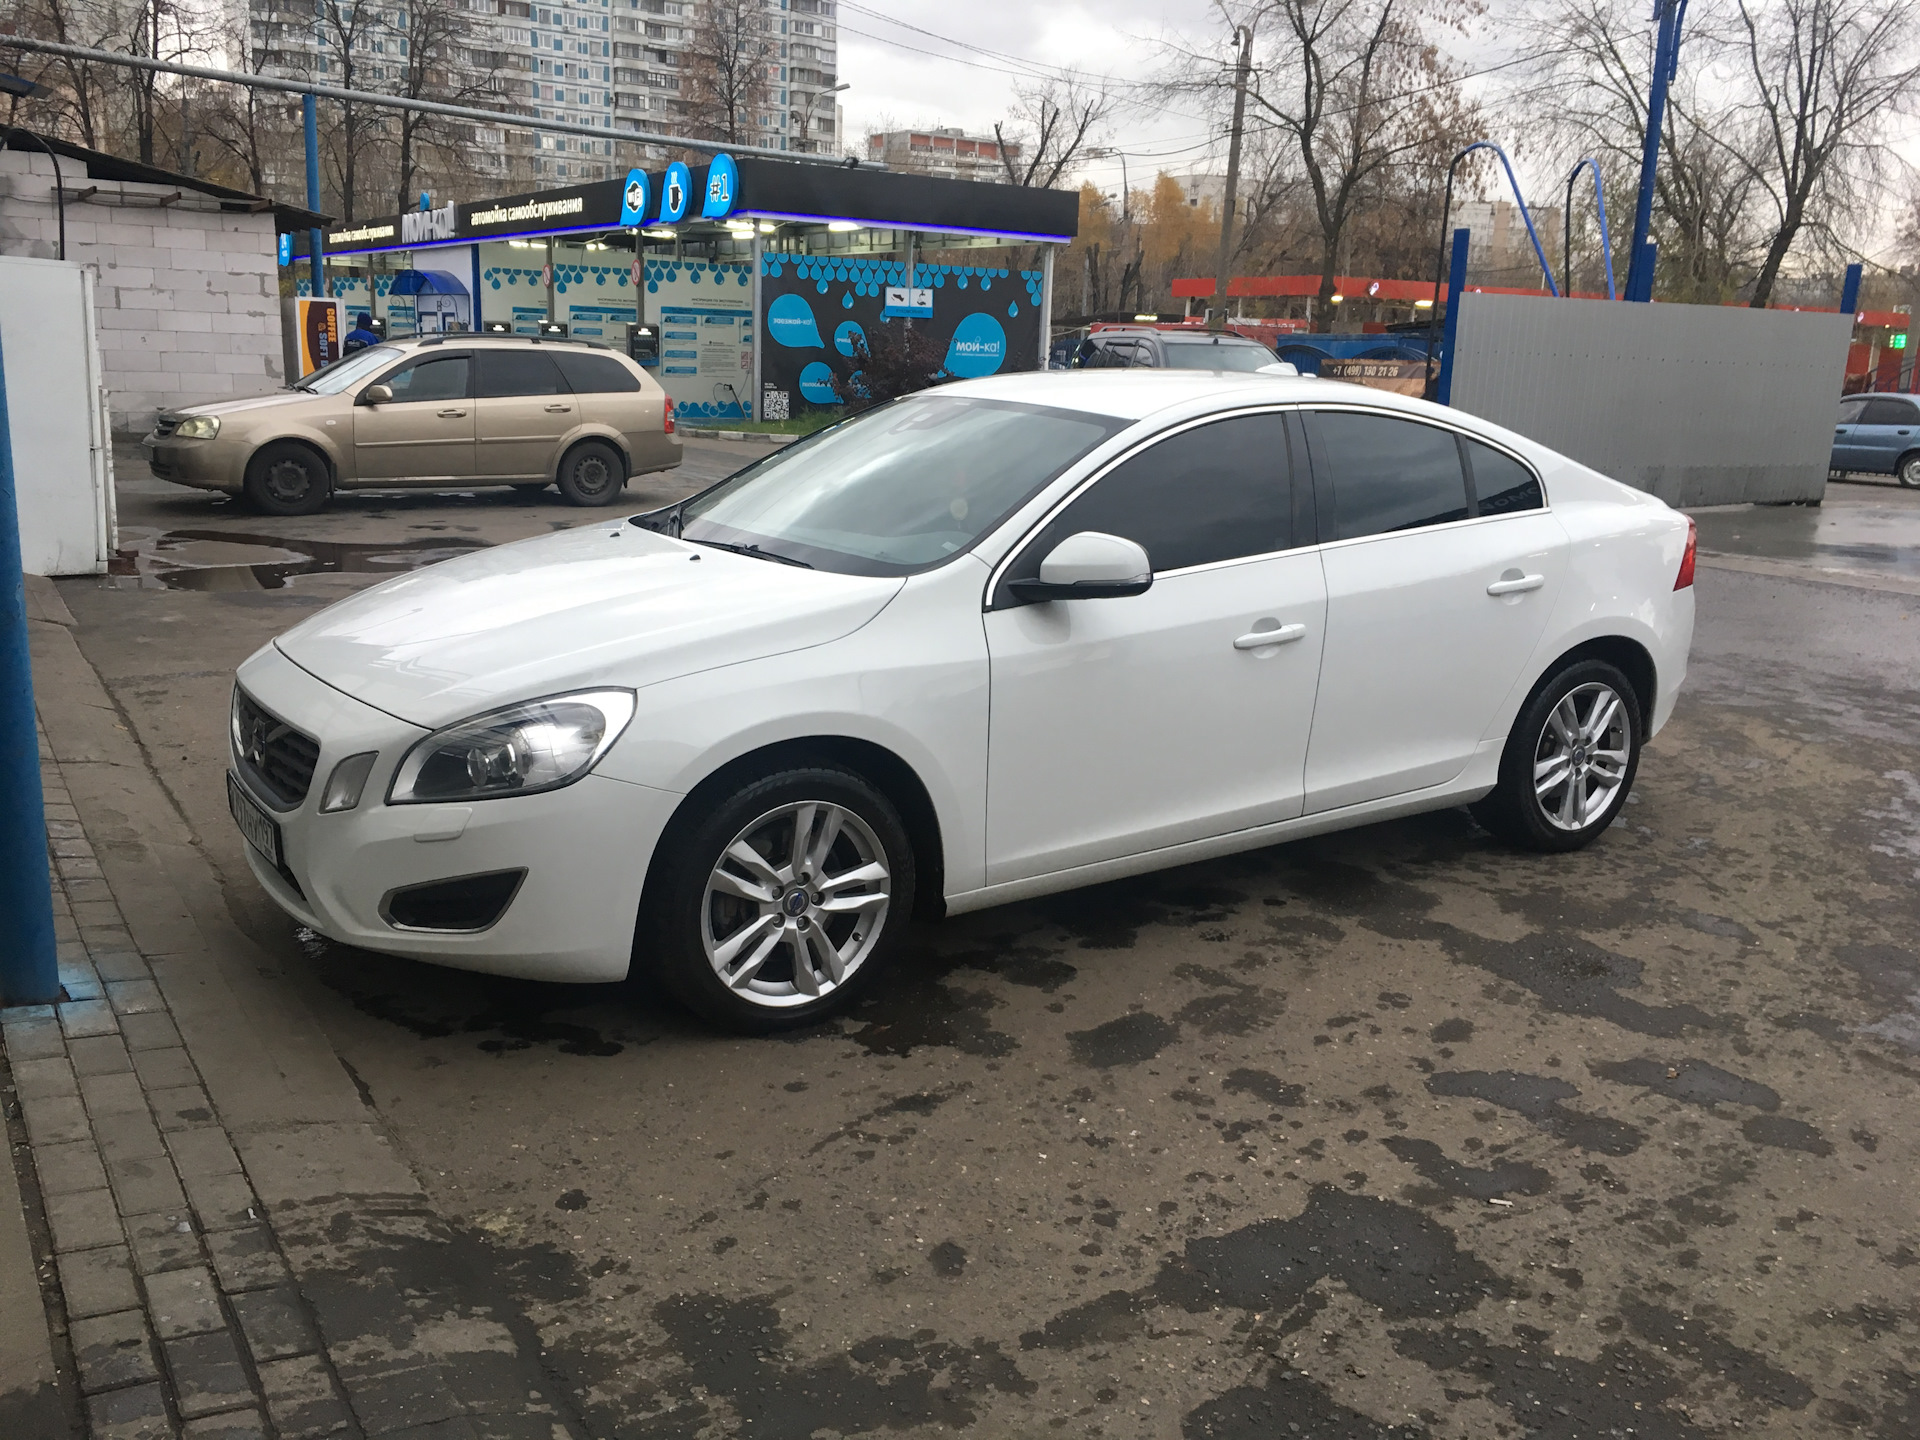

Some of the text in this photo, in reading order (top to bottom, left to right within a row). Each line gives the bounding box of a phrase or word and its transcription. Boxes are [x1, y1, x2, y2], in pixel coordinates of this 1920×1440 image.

[710, 173, 729, 202] #1
[471, 197, 582, 225] автомойка самообслуживания
[327, 307, 337, 343] COFFEE
[319, 332, 329, 358] SOFT
[1333, 365, 1399, 377] +7 (499) 130 21 26
